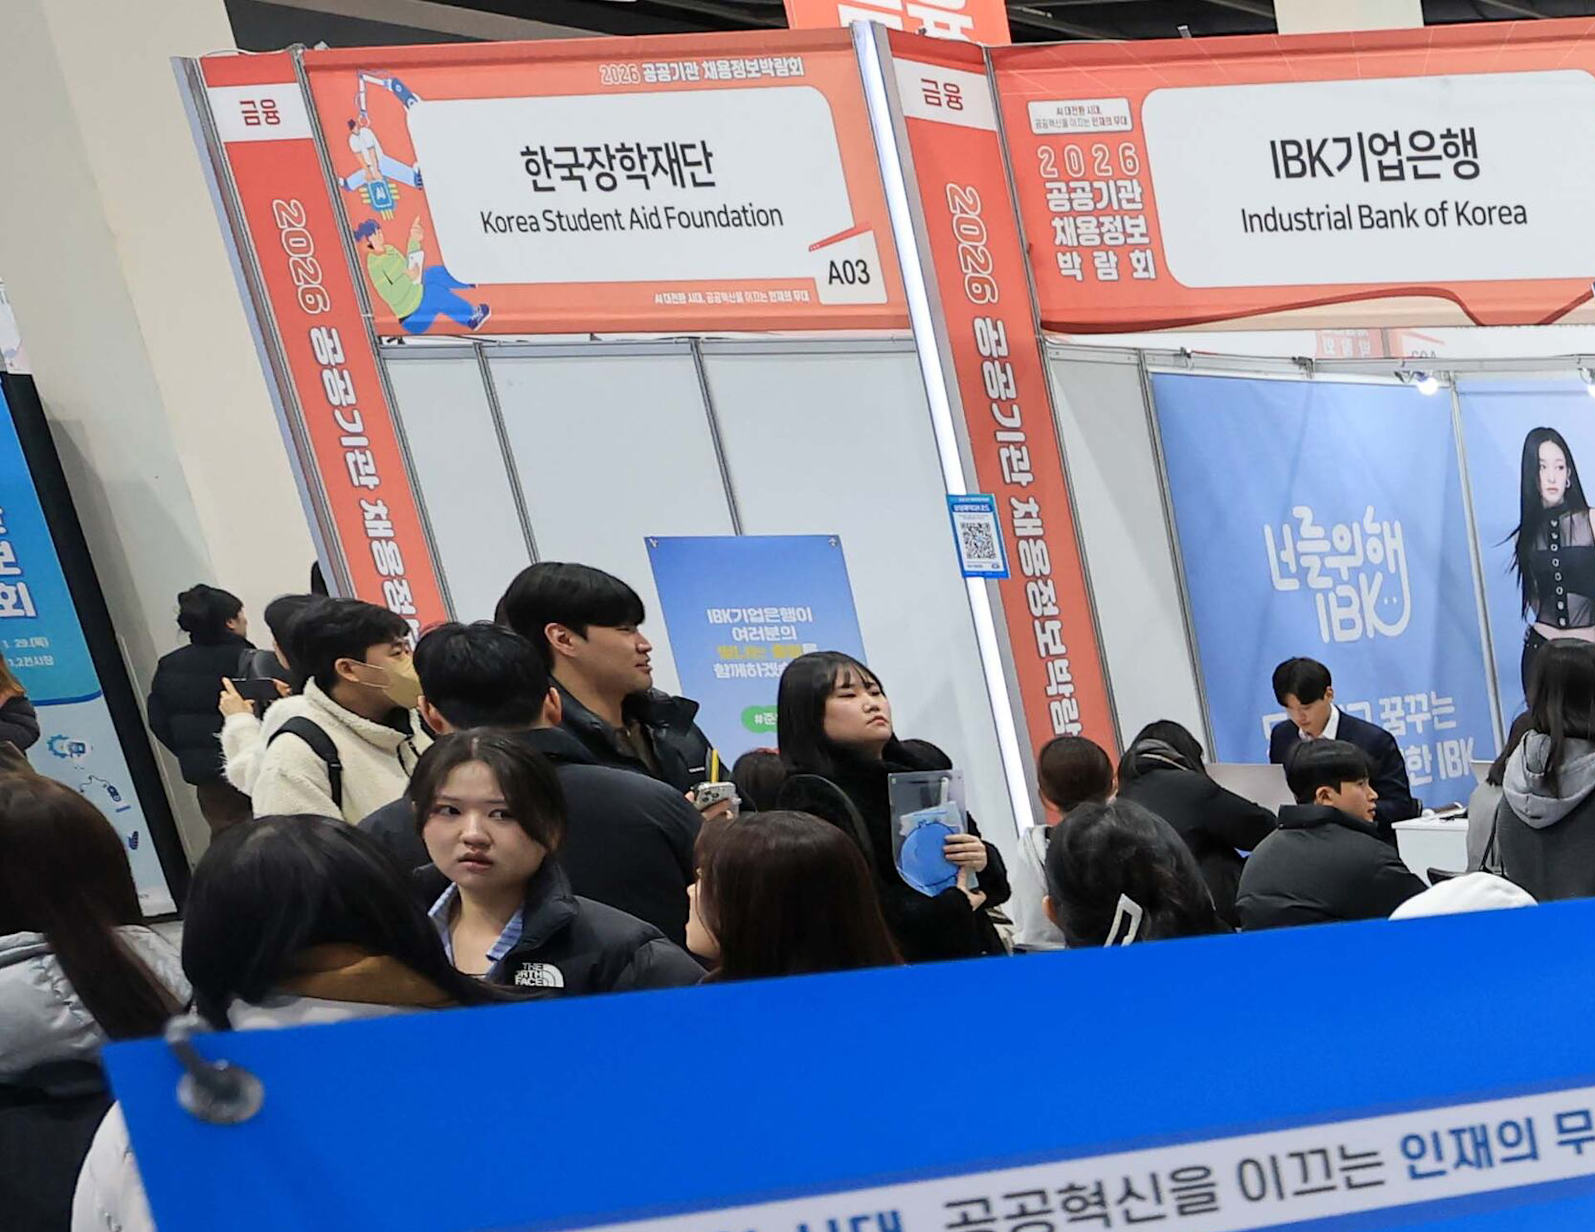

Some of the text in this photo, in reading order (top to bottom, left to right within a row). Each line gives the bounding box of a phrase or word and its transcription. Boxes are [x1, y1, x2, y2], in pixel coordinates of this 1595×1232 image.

[600, 56, 805, 85] 2026 공공기관 채용정보박람회
[920, 77, 964, 112] 금융
[239, 98, 282, 127] 금융
[519, 139, 717, 192] 한국장학재단
[1037, 142, 1140, 178] 2026
[1270, 127, 1480, 182] IBK기업은행
[1044, 178, 1144, 213] 공공기관
[480, 202, 784, 234] Korea Student Aid Foundation
[1051, 214, 1150, 247] 채용정보
[1241, 201, 1528, 233] Industrial Bank of Korea
[827, 259, 871, 285] A03
[271, 197, 331, 315] 2026
[309, 325, 381, 491] 공공기관
[945, 182, 999, 305] 2026
[973, 315, 1034, 488] 공공기관
[1010, 496, 1084, 740] 채용정보박람
[1315, 571, 1411, 644] IBK
[731, 625, 797, 642] 여러분의
[1379, 690, 1457, 736] 꿈꾸는
[1436, 737, 1474, 780] IBK
[515, 970, 543, 979] RTH
[515, 978, 544, 987] FACE
[522, 962, 544, 970] THE
[1236, 1144, 1384, 1202] 이끄는
[1400, 1116, 1538, 1181] 인재의
